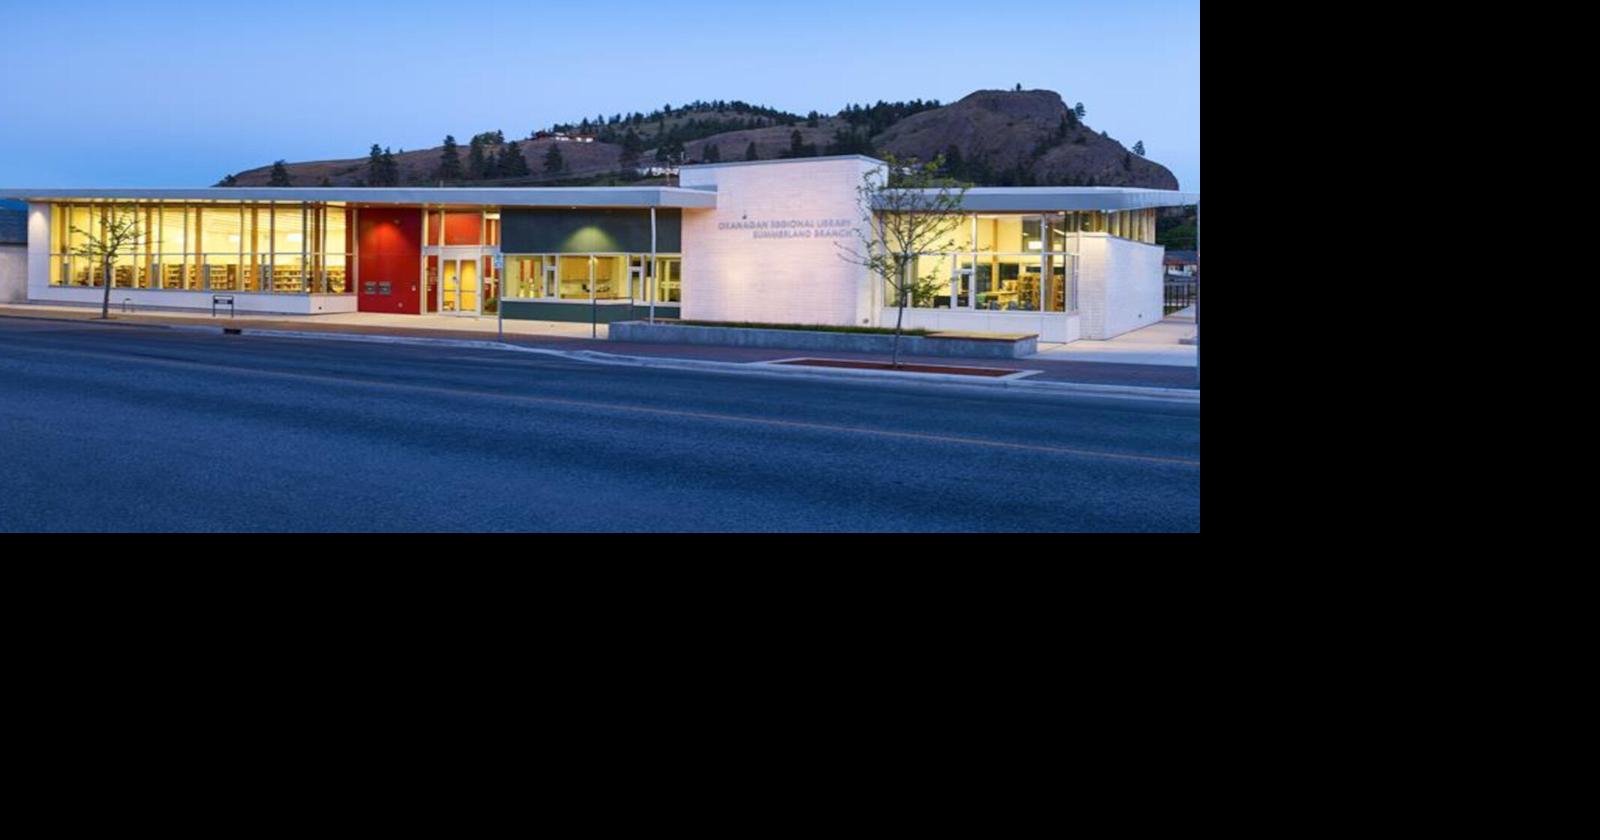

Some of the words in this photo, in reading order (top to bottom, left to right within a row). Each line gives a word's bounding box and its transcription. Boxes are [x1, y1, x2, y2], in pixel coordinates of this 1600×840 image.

[718, 221, 768, 230] OKANAGAN
[771, 219, 814, 229] REGIONAL
[816, 218, 851, 228] LIBRARY
[753, 229, 812, 239] SUMMERLAND
[814, 229, 851, 238] BRANCH
